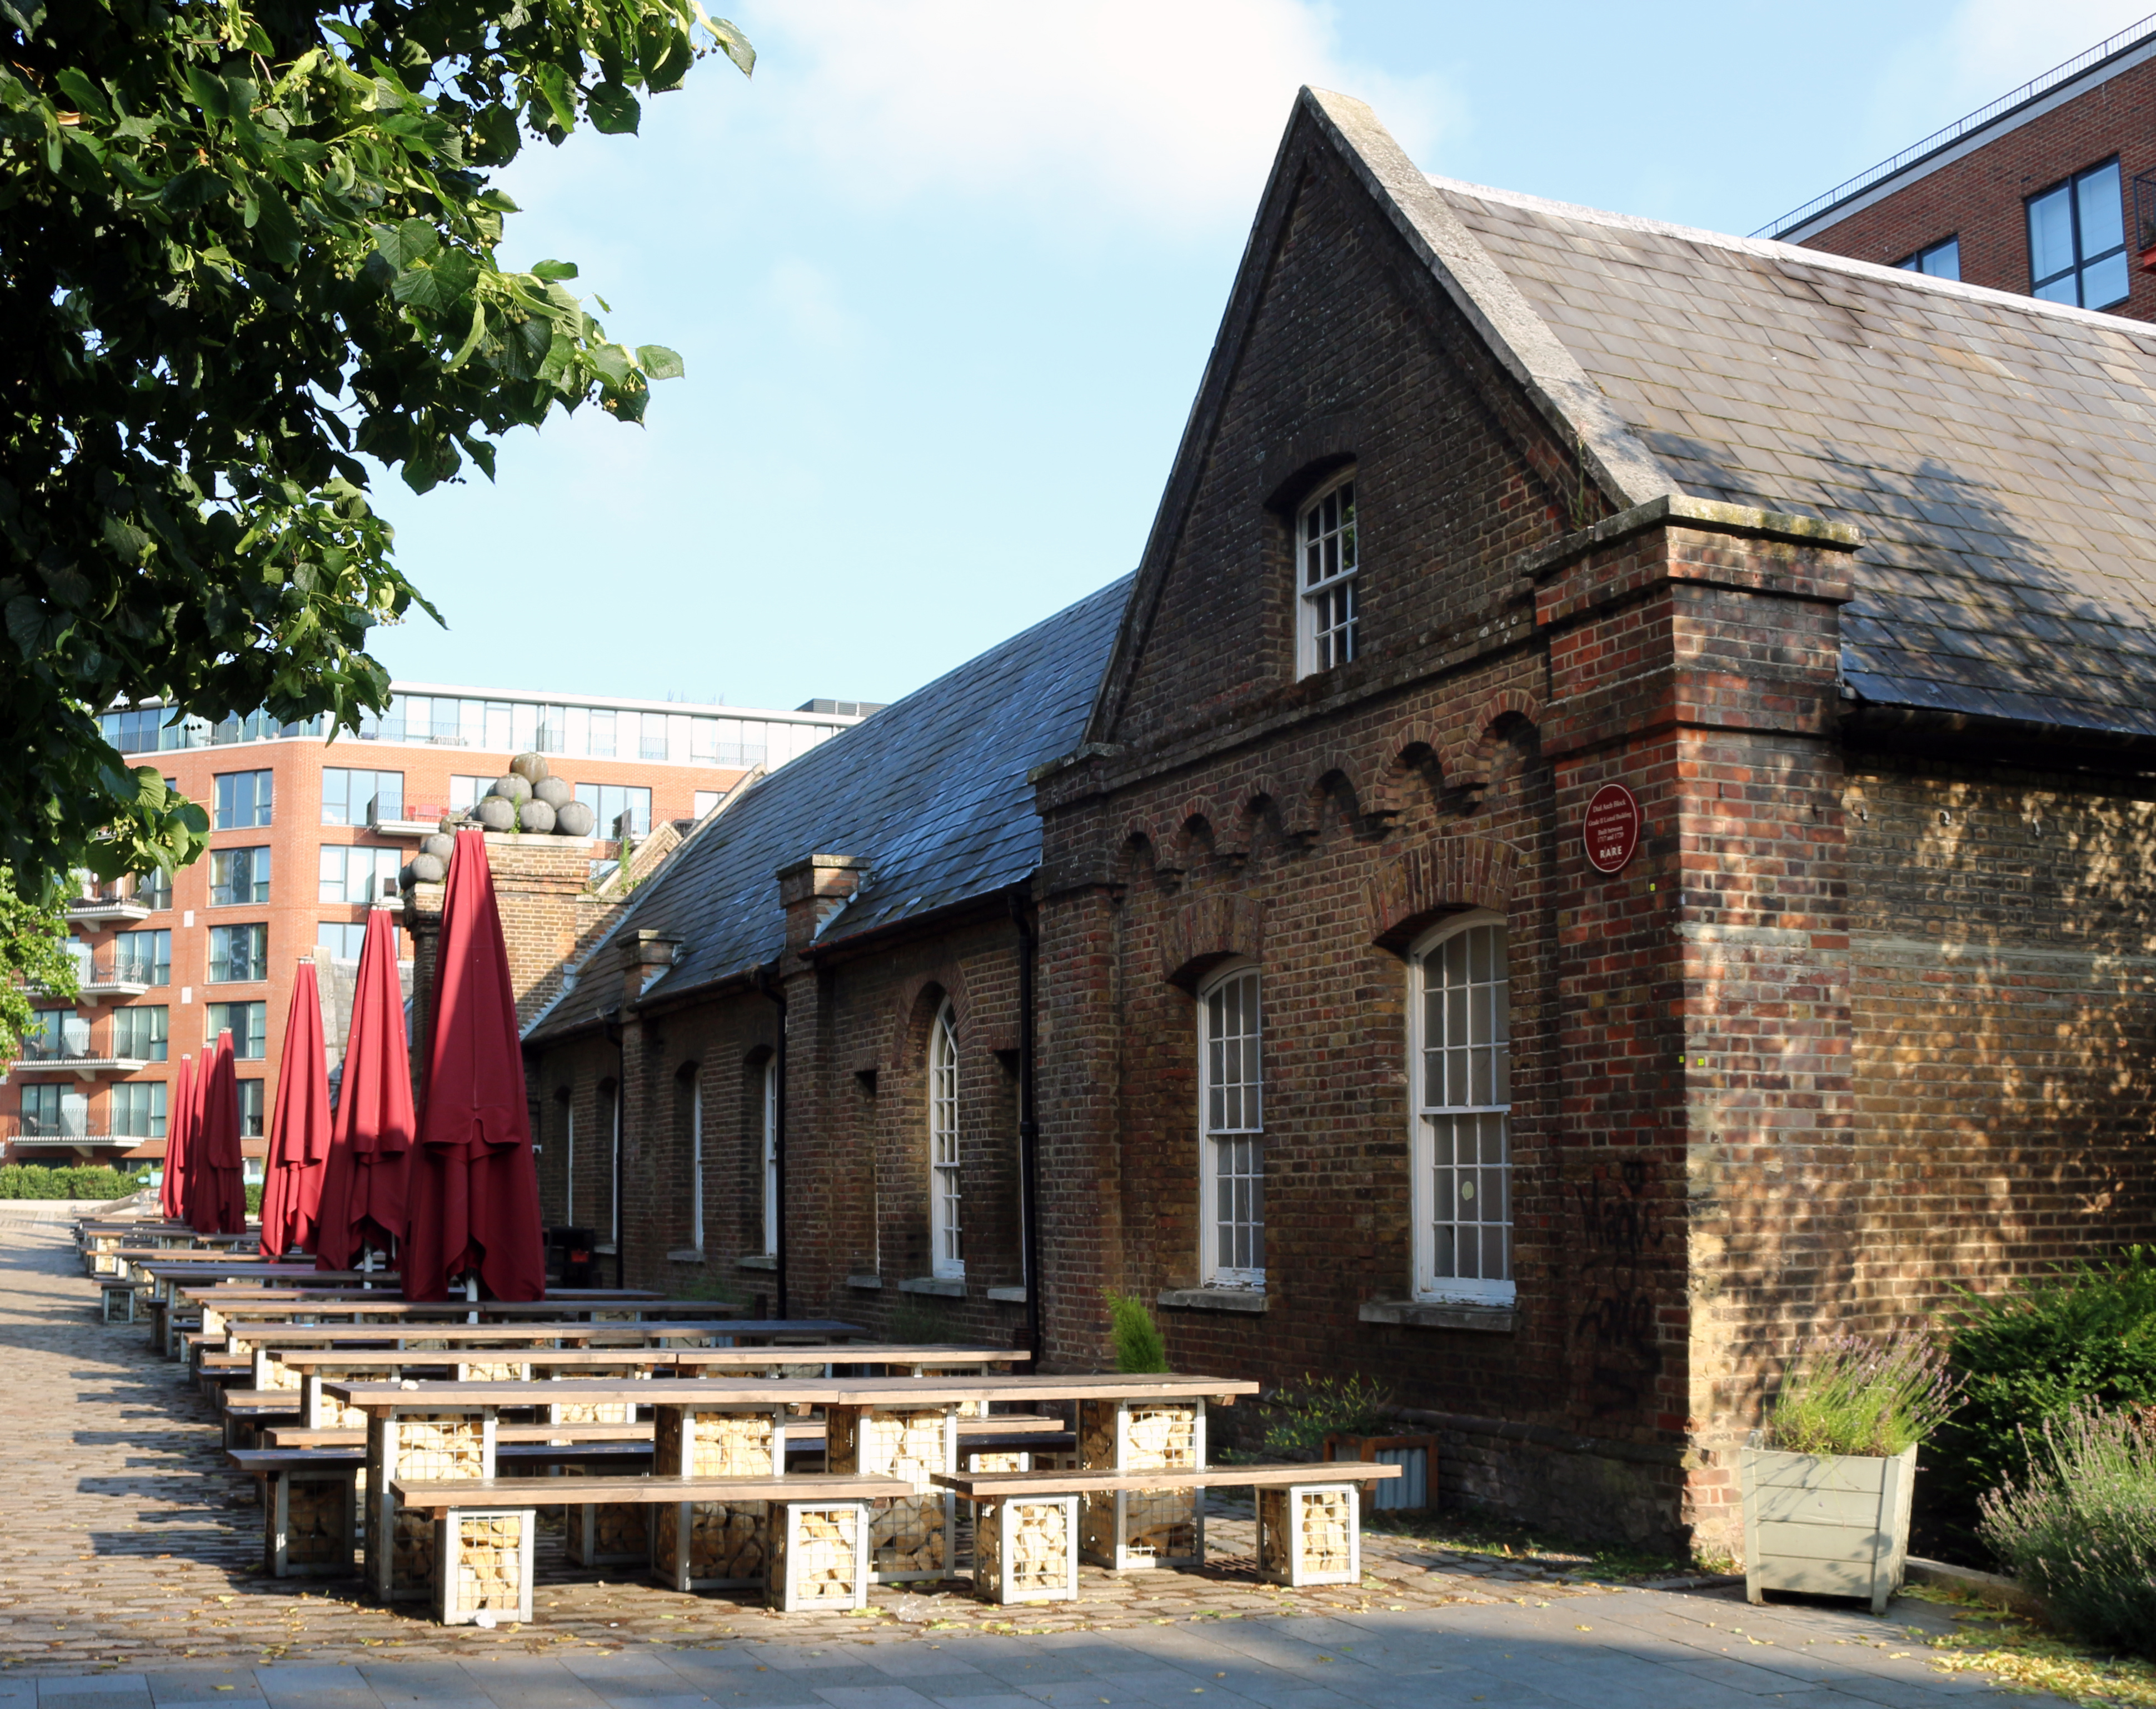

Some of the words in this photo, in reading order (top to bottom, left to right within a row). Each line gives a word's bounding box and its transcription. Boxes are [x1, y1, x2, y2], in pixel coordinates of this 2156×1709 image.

[1614, 799, 1626, 807] Block
[1604, 814, 1615, 823] Listed
[1616, 811, 1632, 820] Building
[1600, 846, 1622, 858] RARE
